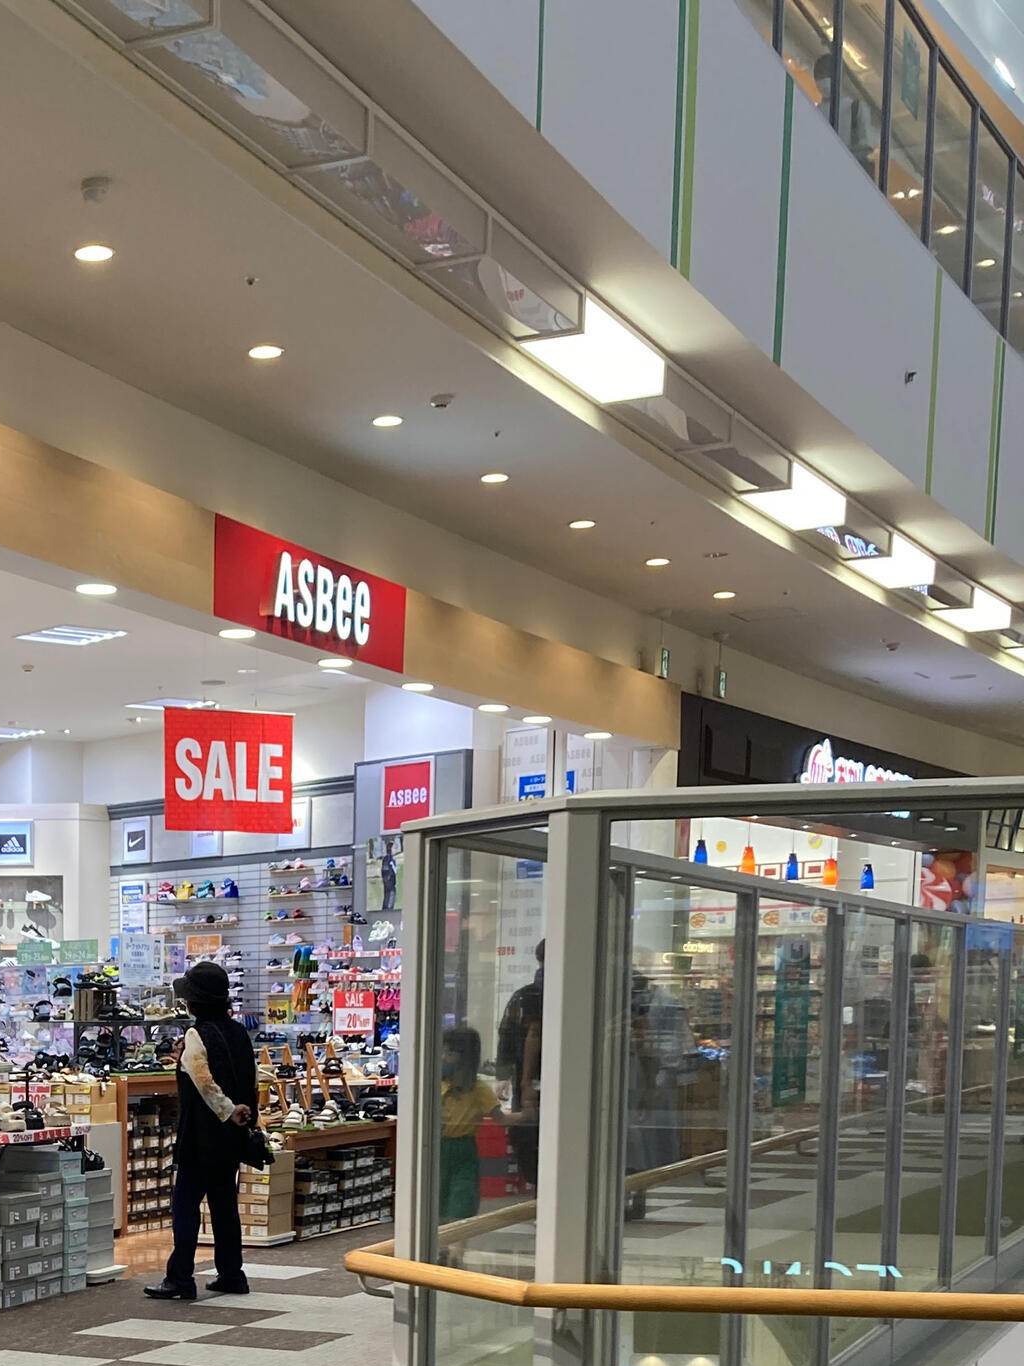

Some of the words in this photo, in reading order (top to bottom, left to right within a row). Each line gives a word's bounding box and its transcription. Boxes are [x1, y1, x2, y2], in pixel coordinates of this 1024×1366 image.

[274, 551, 370, 646] ASBee
[175, 737, 284, 803] SALE
[388, 787, 428, 808] ASBee
[345, 993, 364, 1007] SALE
[39, 1127, 66, 1141] SALE
